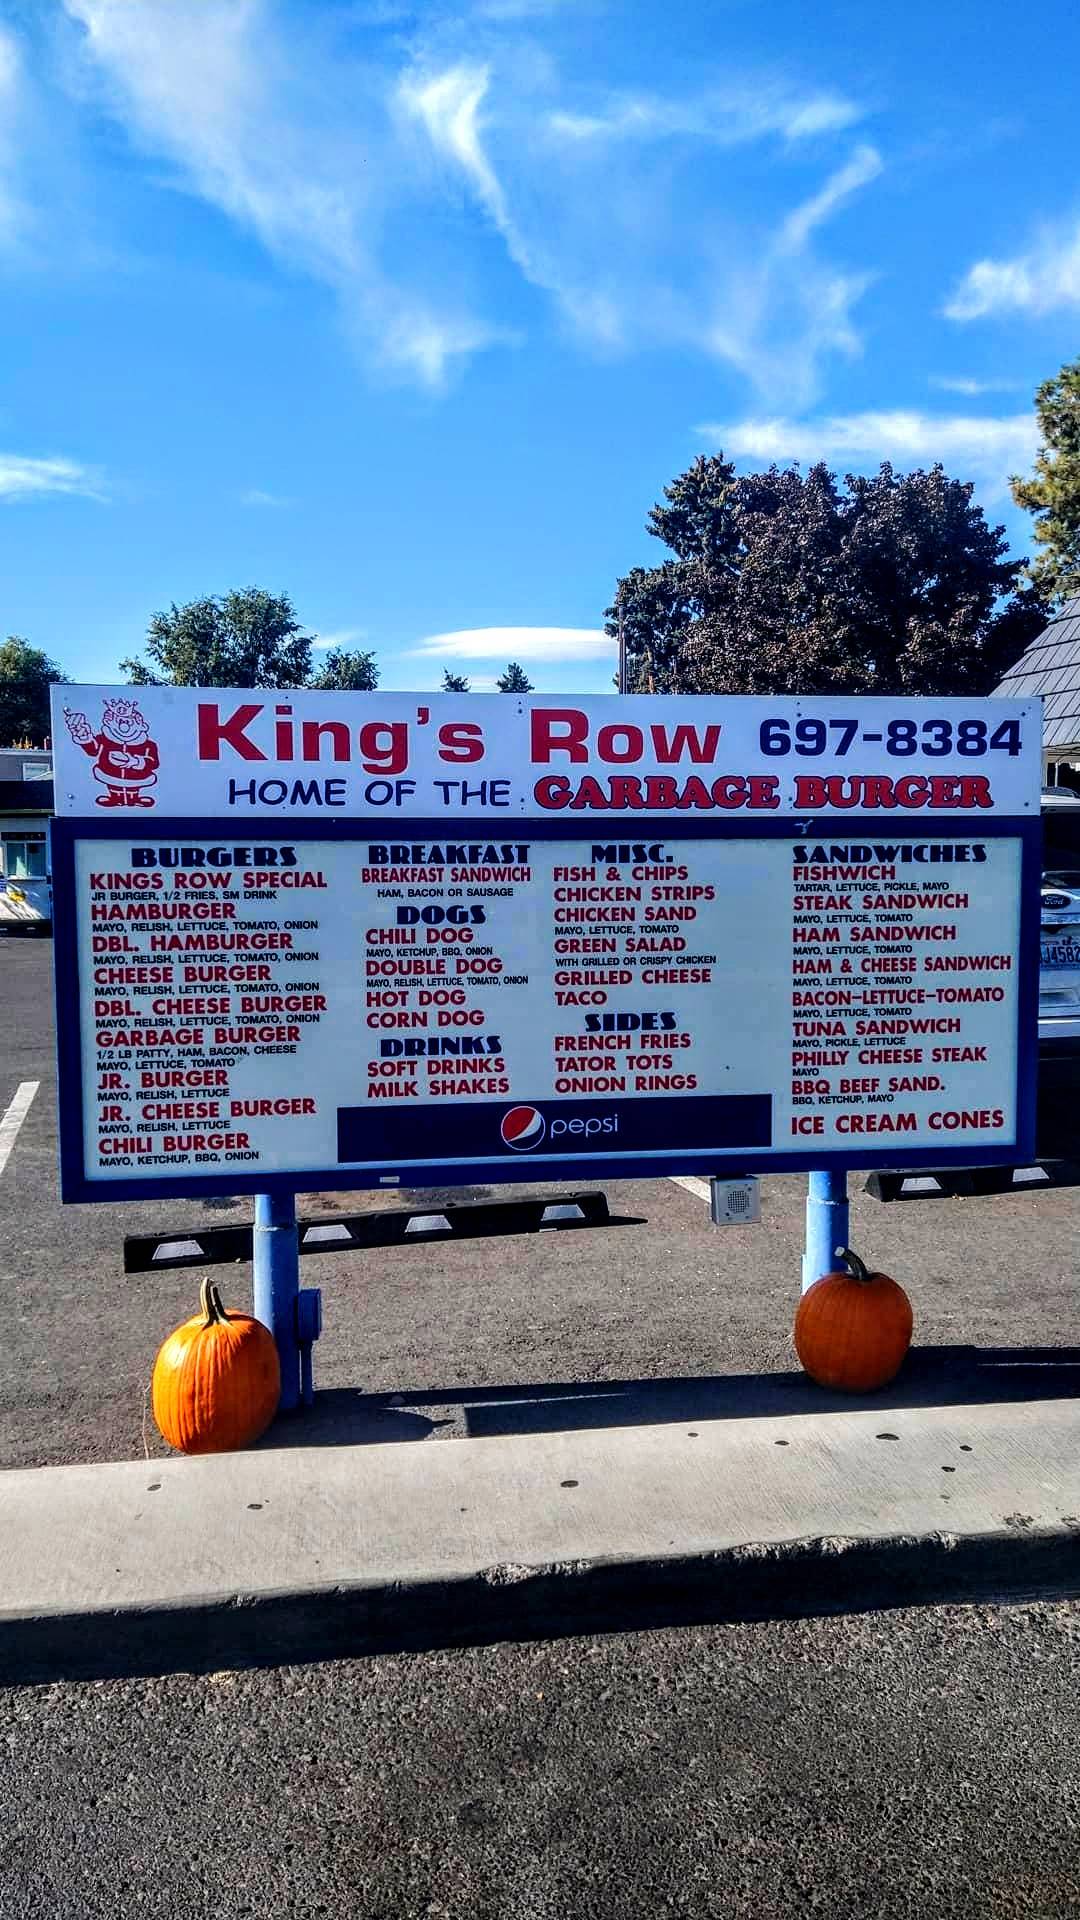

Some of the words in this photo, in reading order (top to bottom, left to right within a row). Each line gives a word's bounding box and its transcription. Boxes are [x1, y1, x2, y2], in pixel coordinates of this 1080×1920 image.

[197, 704, 485, 776] King's
[530, 709, 722, 764] Row
[759, 719, 1023, 756] 697-8384
[228, 780, 346, 806] HOME
[364, 780, 416, 806] OF
[433, 780, 511, 806] THE
[534, 775, 779, 809] GARBAGE
[793, 775, 994, 809] BURGER
[131, 847, 297, 867] BURGERS
[368, 845, 530, 864] BREAKFAST
[592, 845, 673, 863] MISC.
[792, 845, 987, 863] SANDWICHES
[90, 873, 163, 890] KINGS
[174, 872, 232, 889] ROW
[243, 872, 327, 888] SPECIAL
[362, 868, 445, 883] BREAKFAST
[451, 867, 531, 882] SANDWICH
[553, 867, 596, 882] FISH
[606, 867, 620, 881] &
[632, 866, 688, 881] CHIPS
[793, 865, 896, 881] FISHWICH
[92, 892, 105, 901] JR
[110, 891, 159, 902] BURGER,
[163, 891, 181, 900] 1/2
[185, 891, 218, 901] FRIES,
[223, 891, 239, 900] SM
[244, 890, 277, 899] DRINK
[377, 889, 404, 899] HAM,
[408, 888, 443, 897] BACON
[448, 888, 463, 897] OR
[467, 888, 513, 897] SAUSAGE
[554, 887, 641, 902] CHICKEN
[652, 886, 715, 901] STRIPS
[794, 883, 832, 893] TARTAR,
[836, 883, 881, 892] LETTUCE,
[884, 882, 919, 892] PICKLE,
[923, 882, 949, 890] MAYO
[793, 895, 852, 910] STEAK
[863, 894, 969, 909] SANDWICH
[1045, 896, 1064, 904] Ford
[92, 903, 236, 920] HAMBURGER
[397, 905, 486, 925] DOGS
[554, 907, 635, 922] CHICKEN
[645, 907, 697, 921] SAND
[793, 914, 823, 924] MAYO,
[826, 914, 871, 924] LETTUCE,
[875, 913, 913, 922] TOMATO
[92, 922, 127, 933] MAYO,
[132, 922, 173, 932] RELISH,
[178, 921, 229, 932] LETTUCE,
[234, 921, 280, 931] TOMATO,
[284, 920, 318, 930] ONION
[555, 926, 585, 936] MAYO,
[589, 926, 635, 936] LETTUCE,
[640, 925, 679, 934] TOMATO
[793, 927, 840, 942] HAM
[850, 926, 956, 942] SANDWICH
[92, 935, 139, 952] DBL.
[151, 933, 293, 951] HAMBURGER
[366, 928, 416, 945] CHILI
[427, 928, 473, 944] DOG
[554, 938, 616, 953] GREEN
[625, 937, 686, 952] SALAD
[556, 958, 578, 966] WITH
[582, 957, 619, 966] GRILLED
[623, 957, 636, 965] OR
[640, 956, 672, 965] CRISPY
[676, 956, 716, 965] CHICKEN
[1040, 947, 1080, 963] J4582
[366, 959, 446, 976] DOUBLE
[456, 958, 503, 974] DOG
[793, 958, 832, 974] HAM
[840, 958, 852, 973] &
[861, 957, 917, 972] CHEESE
[924, 955, 1011, 971] SANDWICH
[94, 967, 173, 984] CHEESE
[185, 965, 271, 982] BURGER
[554, 970, 632, 986] GRILLED
[642, 969, 711, 984] CHEESE
[95, 987, 128, 997] MAYO,
[133, 986, 175, 996] RELISH,
[179, 985, 230, 995] LETTUCE,
[235, 984, 281, 994] TOMATO,
[285, 983, 320, 992] ONION
[366, 991, 408, 1007] HOT
[419, 990, 466, 1006] DOG
[555, 991, 607, 1006] TACO
[792, 987, 1004, 1006] BACON-LETTUCE-TOMATO
[95, 1000, 141, 1017] DBL.
[152, 998, 230, 1015] CHEESE
[241, 996, 328, 1013] BURGER
[793, 1009, 822, 1018] MAYO,
[826, 1008, 870, 1018] LETTUCE,
[874, 1007, 912, 1016] TOMATO
[366, 1012, 428, 1029] CORN
[438, 1011, 485, 1027] DOG
[585, 1012, 677, 1032] SIDES
[793, 1021, 846, 1037] TUNA
[856, 1019, 961, 1035] SANDWICH
[96, 1028, 204, 1047] GARBAGE
[215, 1026, 301, 1044] BURGER
[554, 1035, 632, 1051] FRENCH
[640, 1033, 691, 1050] FRIES
[793, 1039, 822, 1049] MAYO,
[826, 1038, 861, 1048] PICKLE,
[865, 1037, 906, 1046] LETTUCE
[97, 1050, 114, 1059] 1/2
[119, 1049, 132, 1058] LB
[137, 1048, 173, 1059] PATTY,
[178, 1047, 205, 1058] HAM,
[209, 1046, 249, 1057] BACON,
[254, 1045, 297, 1055] CHEESE
[380, 1036, 502, 1057] DRINKS
[97, 1061, 131, 1072] MAYO,
[135, 1059, 187, 1071] LETTUCE,
[191, 1058, 235, 1068] TOMATO
[555, 1056, 616, 1072] TATOR
[626, 1055, 673, 1071] TOTS
[792, 1051, 849, 1067] PHILLY
[859, 1049, 923, 1065] CHEESE
[932, 1047, 987, 1063] STEAK
[367, 1060, 417, 1077] SOFT
[427, 1058, 505, 1075] DRINKS
[792, 1068, 819, 1076] MAYO
[98, 1072, 130, 1089] JR.
[141, 1070, 229, 1088] BURGER
[367, 1081, 418, 1098] MILK
[429, 1078, 509, 1096] SHAKES
[555, 1076, 626, 1093] ONION
[636, 1075, 698, 1091] RINGS
[792, 1080, 830, 1095] BBQ
[840, 1078, 880, 1094] BEEF
[889, 1077, 945, 1092] SAND.
[98, 1091, 132, 1102] MAYO,
[136, 1090, 177, 1101] RELISH,
[182, 1089, 230, 1099] LETTUCE
[99, 1105, 131, 1122] JR.
[142, 1101, 220, 1120] CHEESE
[231, 1098, 316, 1117] BURGER
[550, 1114, 618, 1138] pepsi
[791, 1116, 824, 1135] ICE
[836, 1113, 917, 1134] CREAM
[928, 1110, 1004, 1131] CONES
[99, 1136, 152, 1154] CHILI
[164, 1133, 249, 1152] BURGER
[99, 1156, 133, 1167] MAYO,
[137, 1154, 191, 1166] KETCHUP,
[195, 1153, 221, 1163] BBQ,
[225, 1151, 259, 1161] ONION
